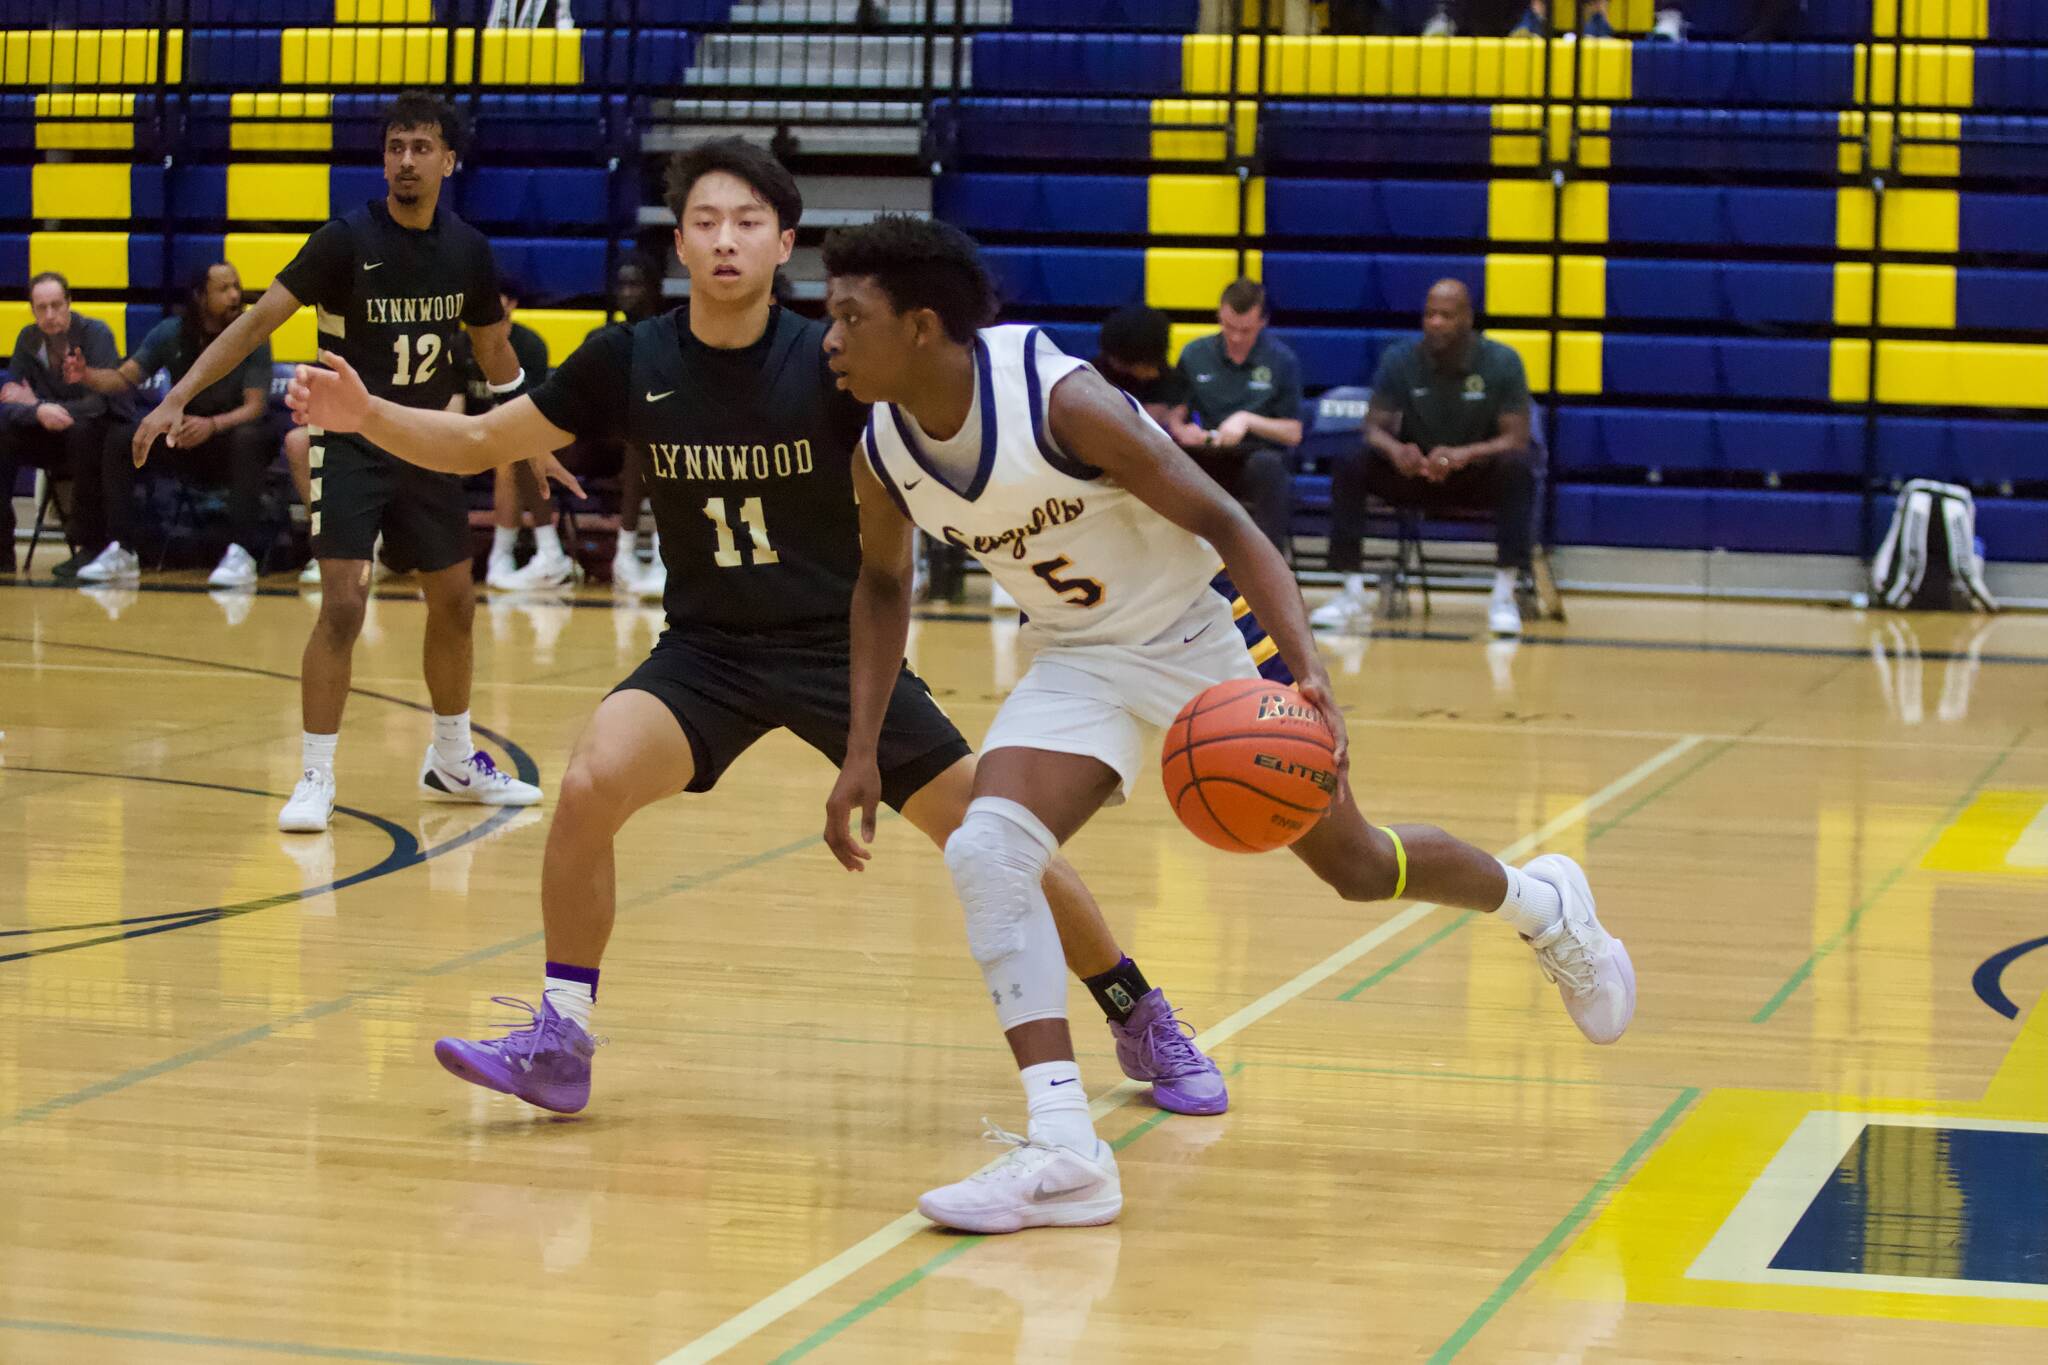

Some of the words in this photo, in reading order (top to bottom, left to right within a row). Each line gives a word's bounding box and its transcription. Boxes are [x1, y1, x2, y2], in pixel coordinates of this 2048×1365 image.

[367, 293, 464, 323] LYNNWOOD
[392, 333, 442, 386] 12
[650, 439, 813, 480] LYNNWOOD
[702, 496, 780, 567] 11
[942, 497, 1085, 560] Seagulls
[1031, 553, 1106, 608] 5
[1254, 754, 1326, 785] ELITE
